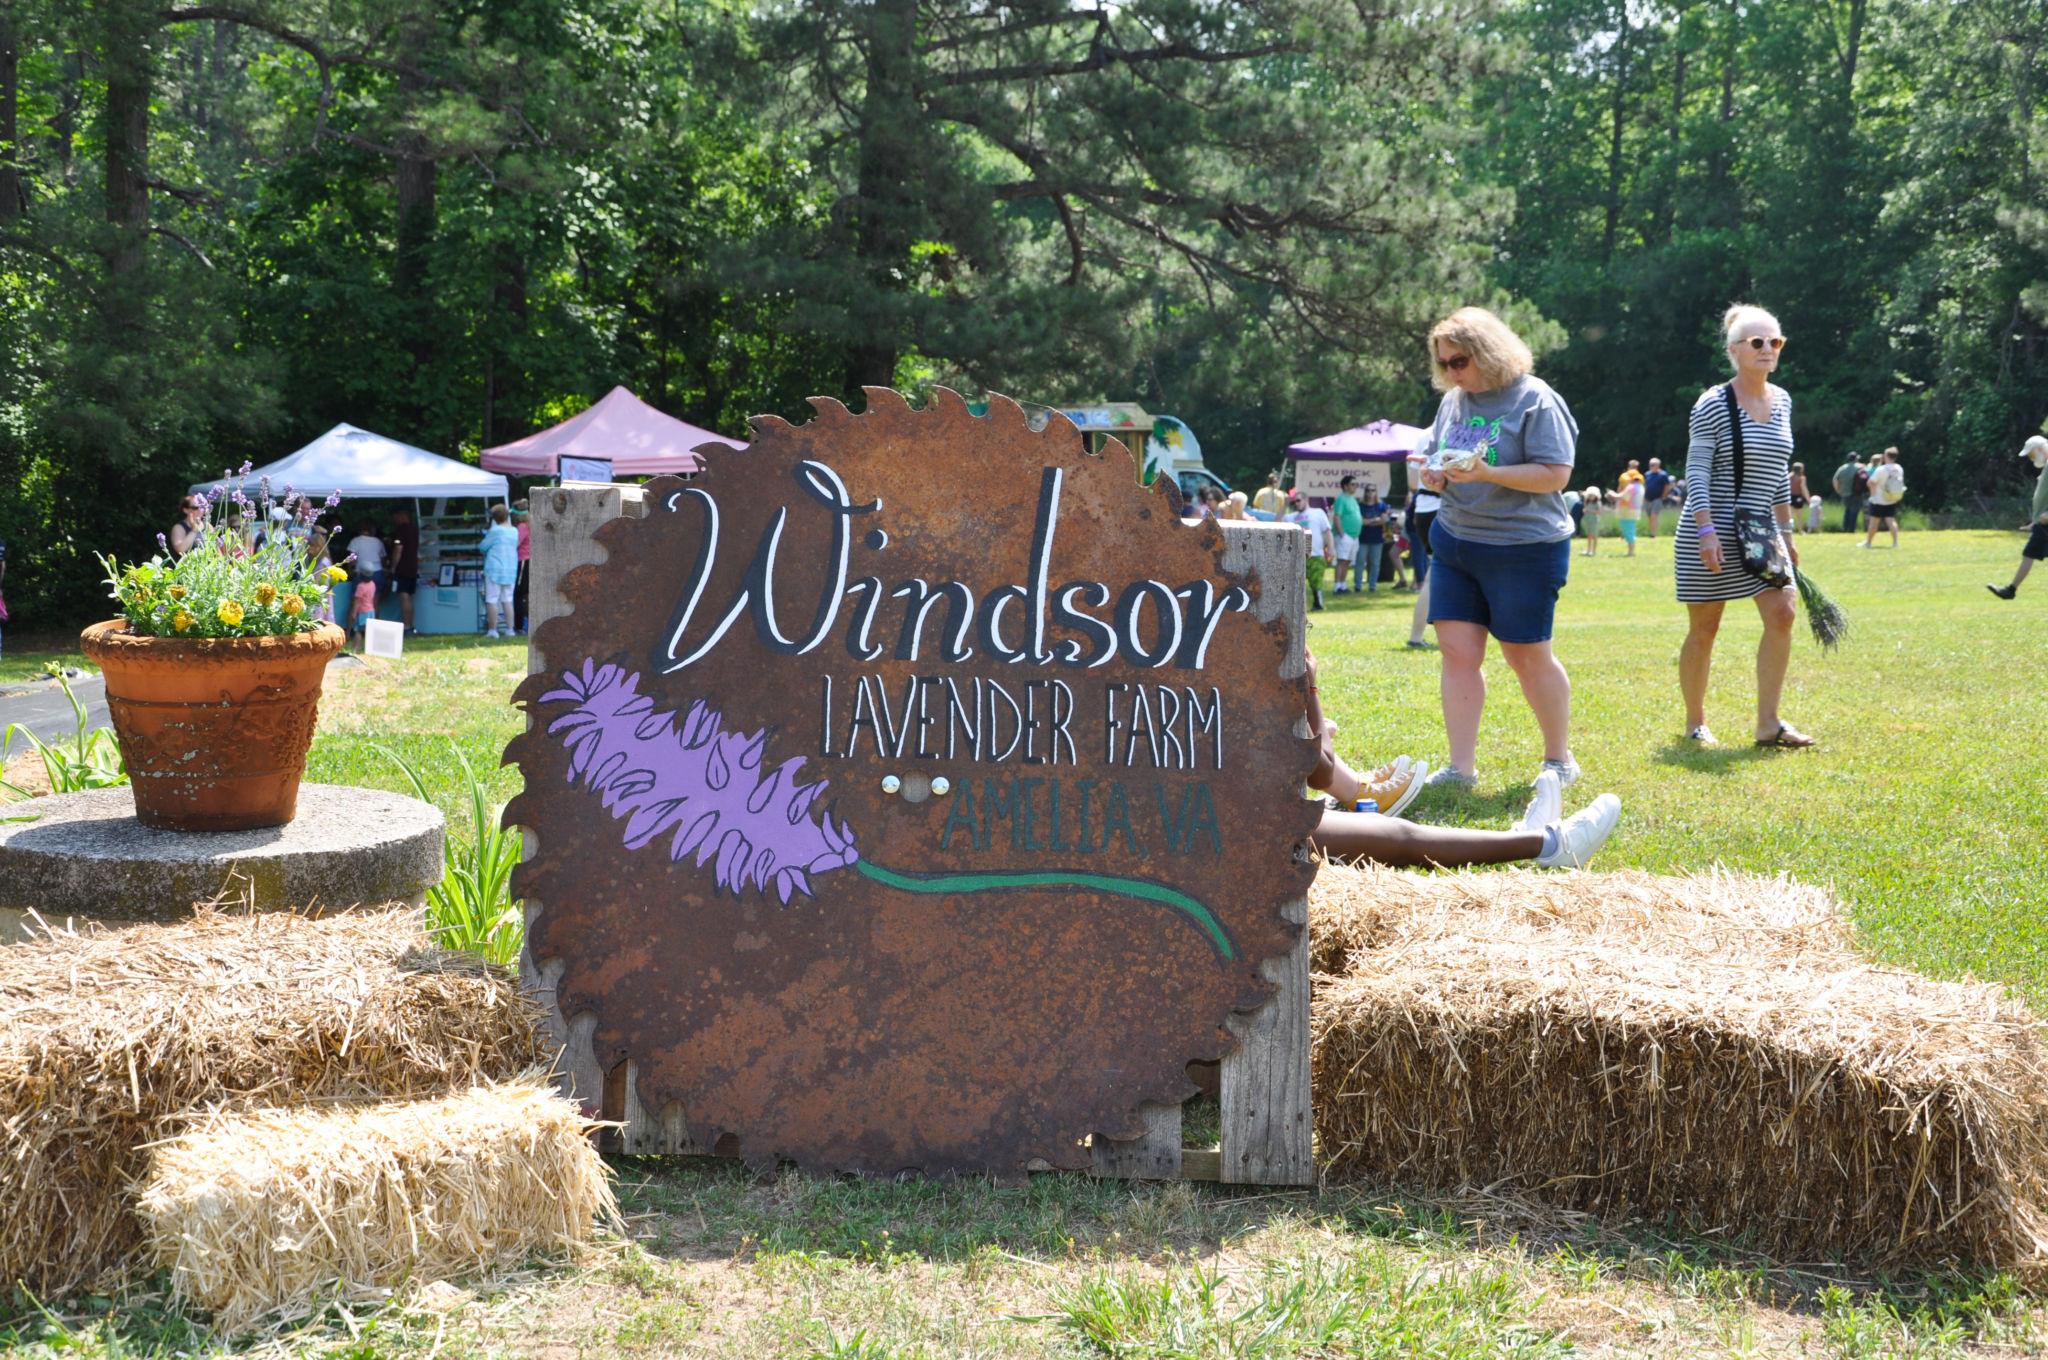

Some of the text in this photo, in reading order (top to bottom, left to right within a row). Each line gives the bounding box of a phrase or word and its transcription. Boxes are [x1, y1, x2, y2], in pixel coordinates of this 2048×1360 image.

[1315, 468, 1372, 478] YOU PICK
[651, 460, 1251, 674] Windsor
[820, 674, 1224, 770] LAVENDER FARM
[941, 776, 1223, 860] AMELIA, VA
